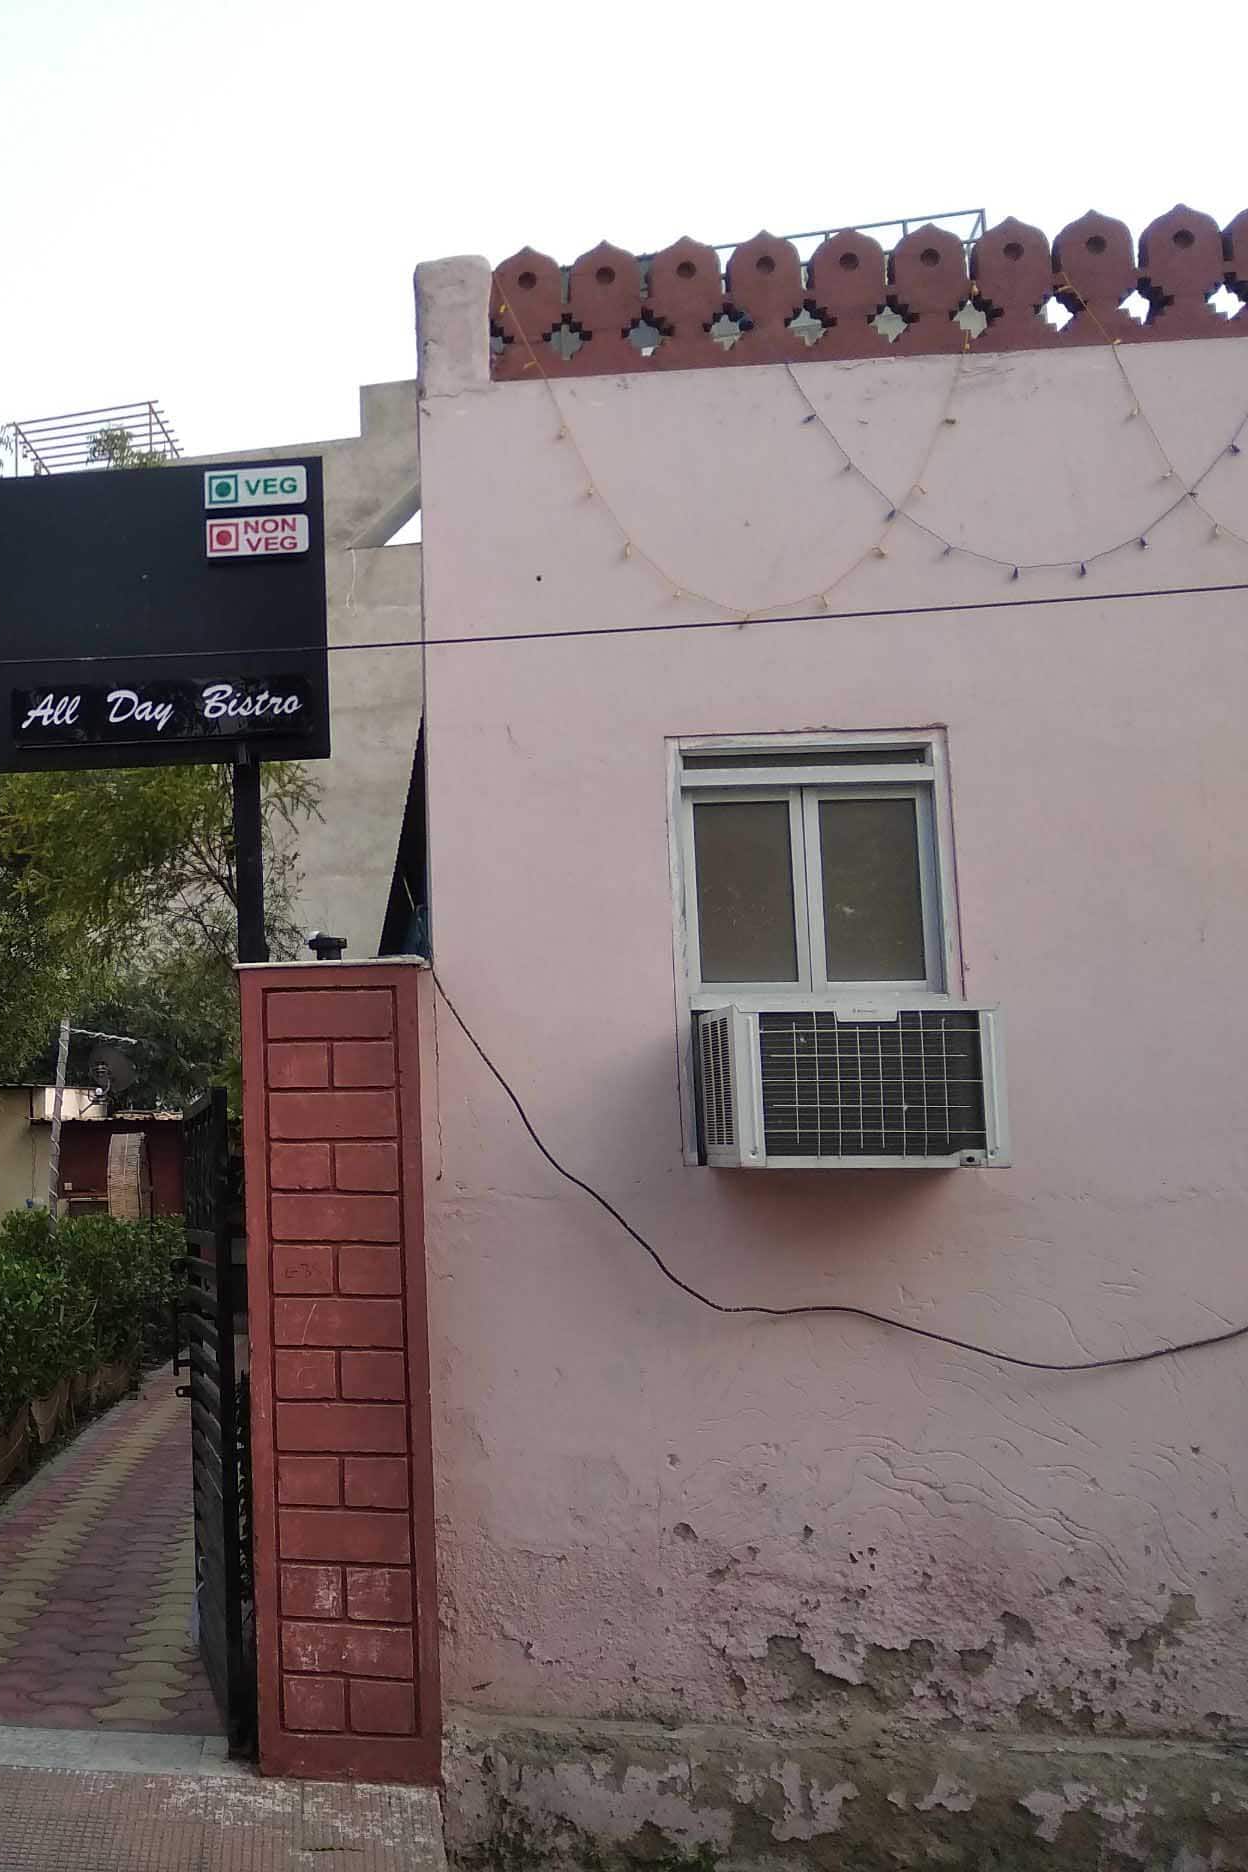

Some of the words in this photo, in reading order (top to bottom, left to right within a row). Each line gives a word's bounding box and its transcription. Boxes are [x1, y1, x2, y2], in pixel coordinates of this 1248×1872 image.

[245, 477, 298, 496] VEG
[244, 517, 297, 534] NON
[246, 536, 298, 552] VEG
[21, 693, 82, 729] All
[105, 689, 176, 732] Day
[201, 684, 304, 719] Bistro
